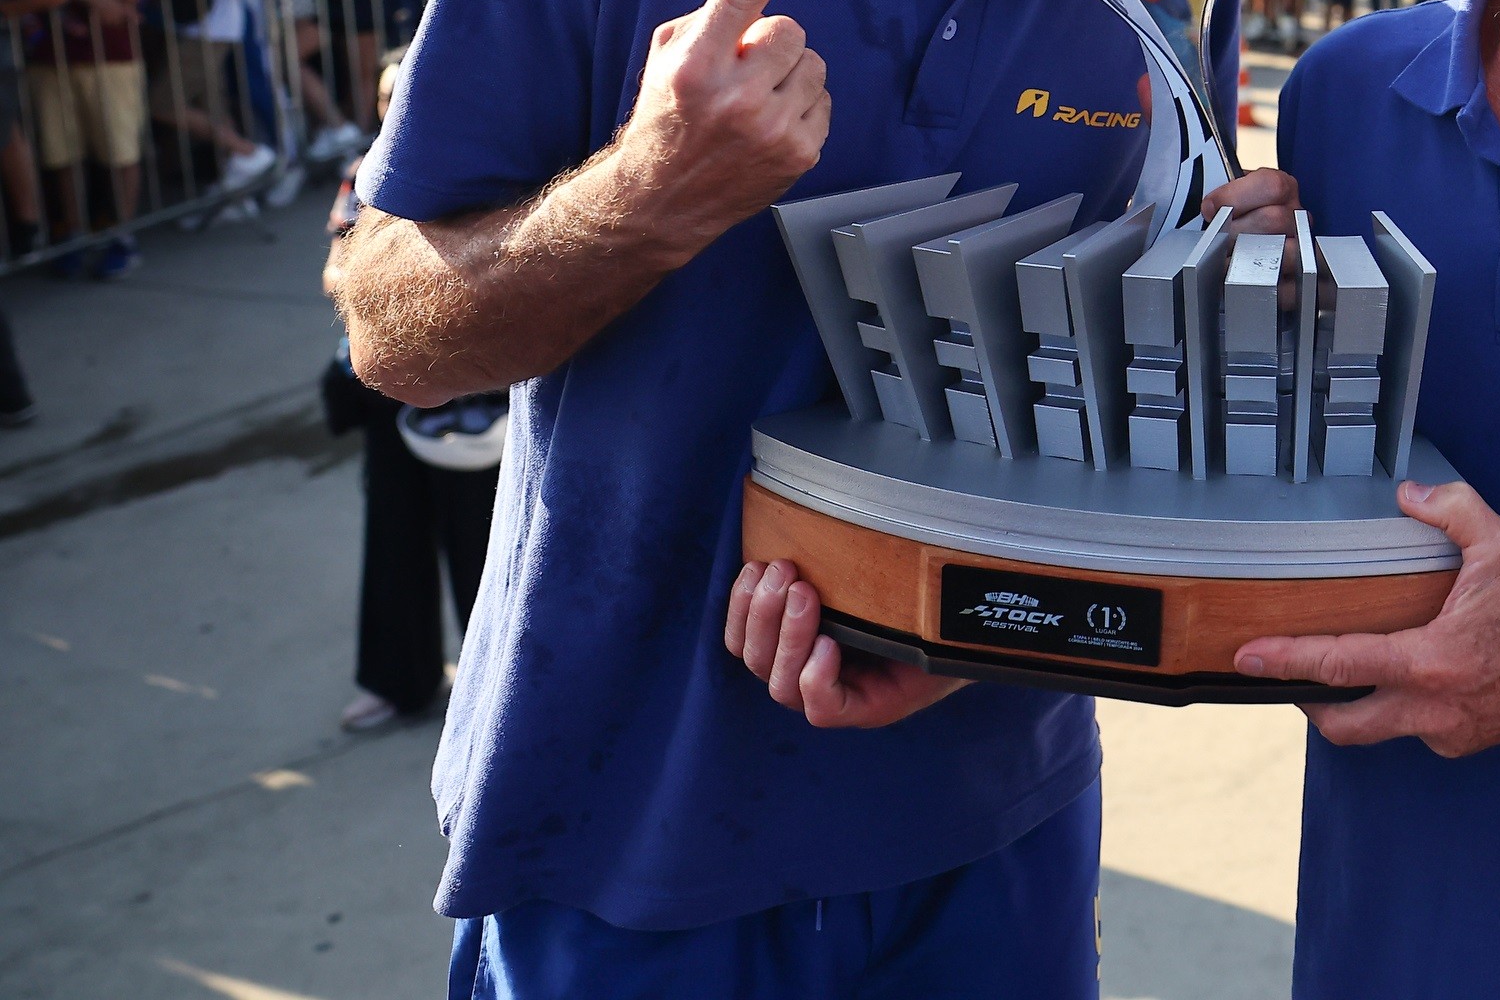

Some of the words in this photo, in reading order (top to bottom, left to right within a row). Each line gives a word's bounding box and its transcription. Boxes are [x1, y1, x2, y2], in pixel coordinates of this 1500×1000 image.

[1053, 105, 1142, 128] RACING
[997, 592, 1028, 605] BH
[1095, 628, 1117, 636] LUGAR
